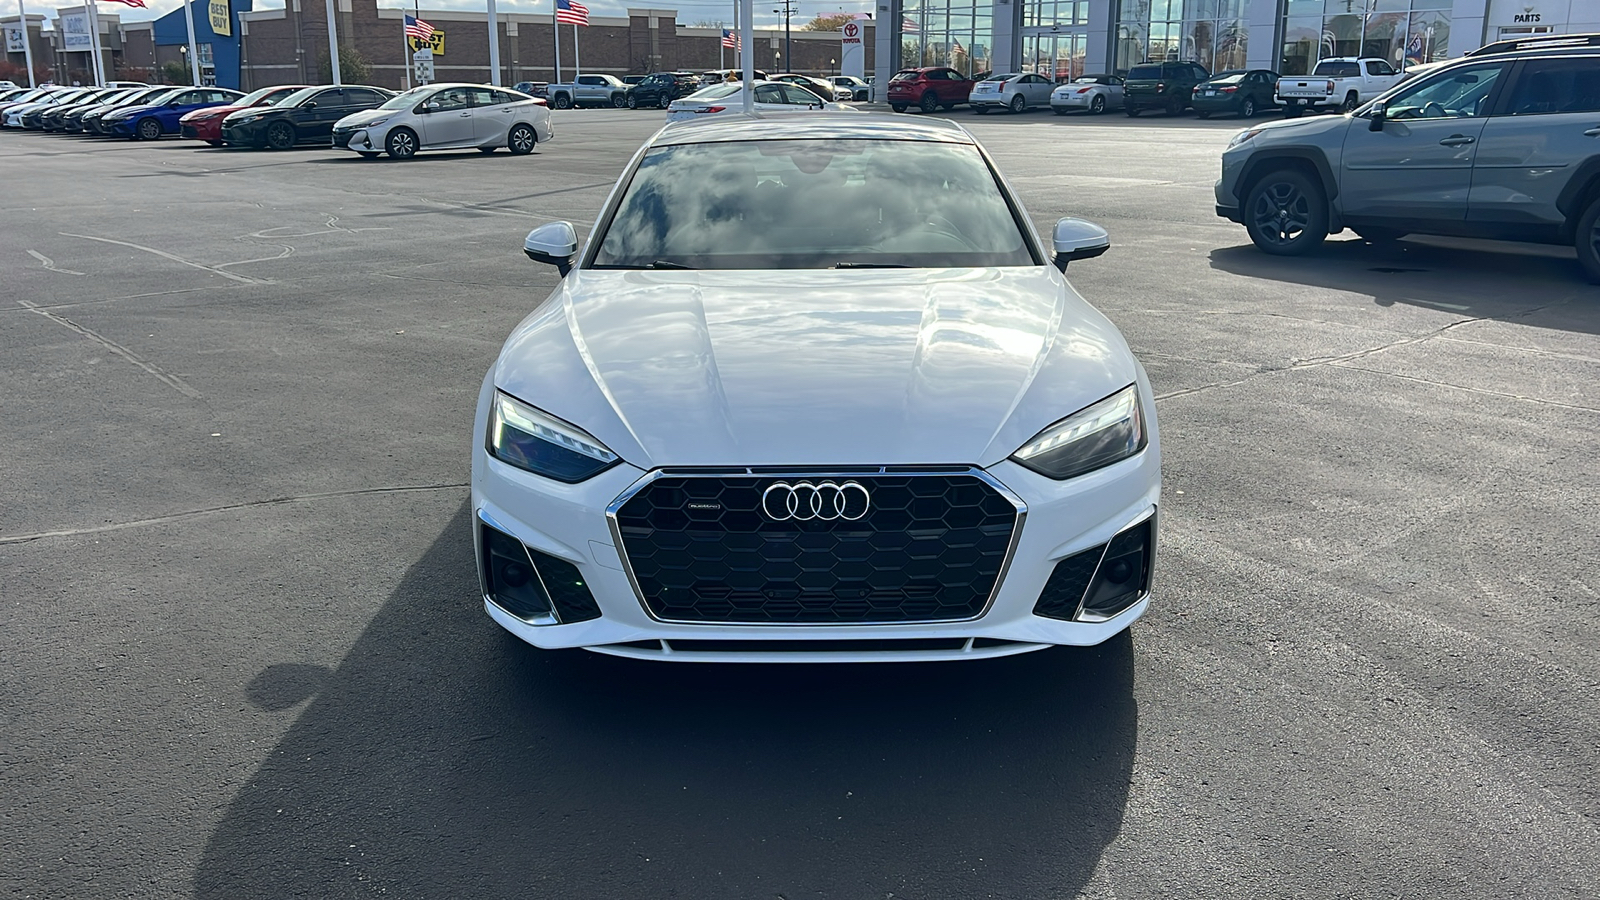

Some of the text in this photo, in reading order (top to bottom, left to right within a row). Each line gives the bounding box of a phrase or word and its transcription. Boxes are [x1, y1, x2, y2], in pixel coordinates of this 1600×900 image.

[211, 3, 227, 16] BEST
[213, 16, 227, 29] BUY
[1514, 14, 1541, 23] PARTS
